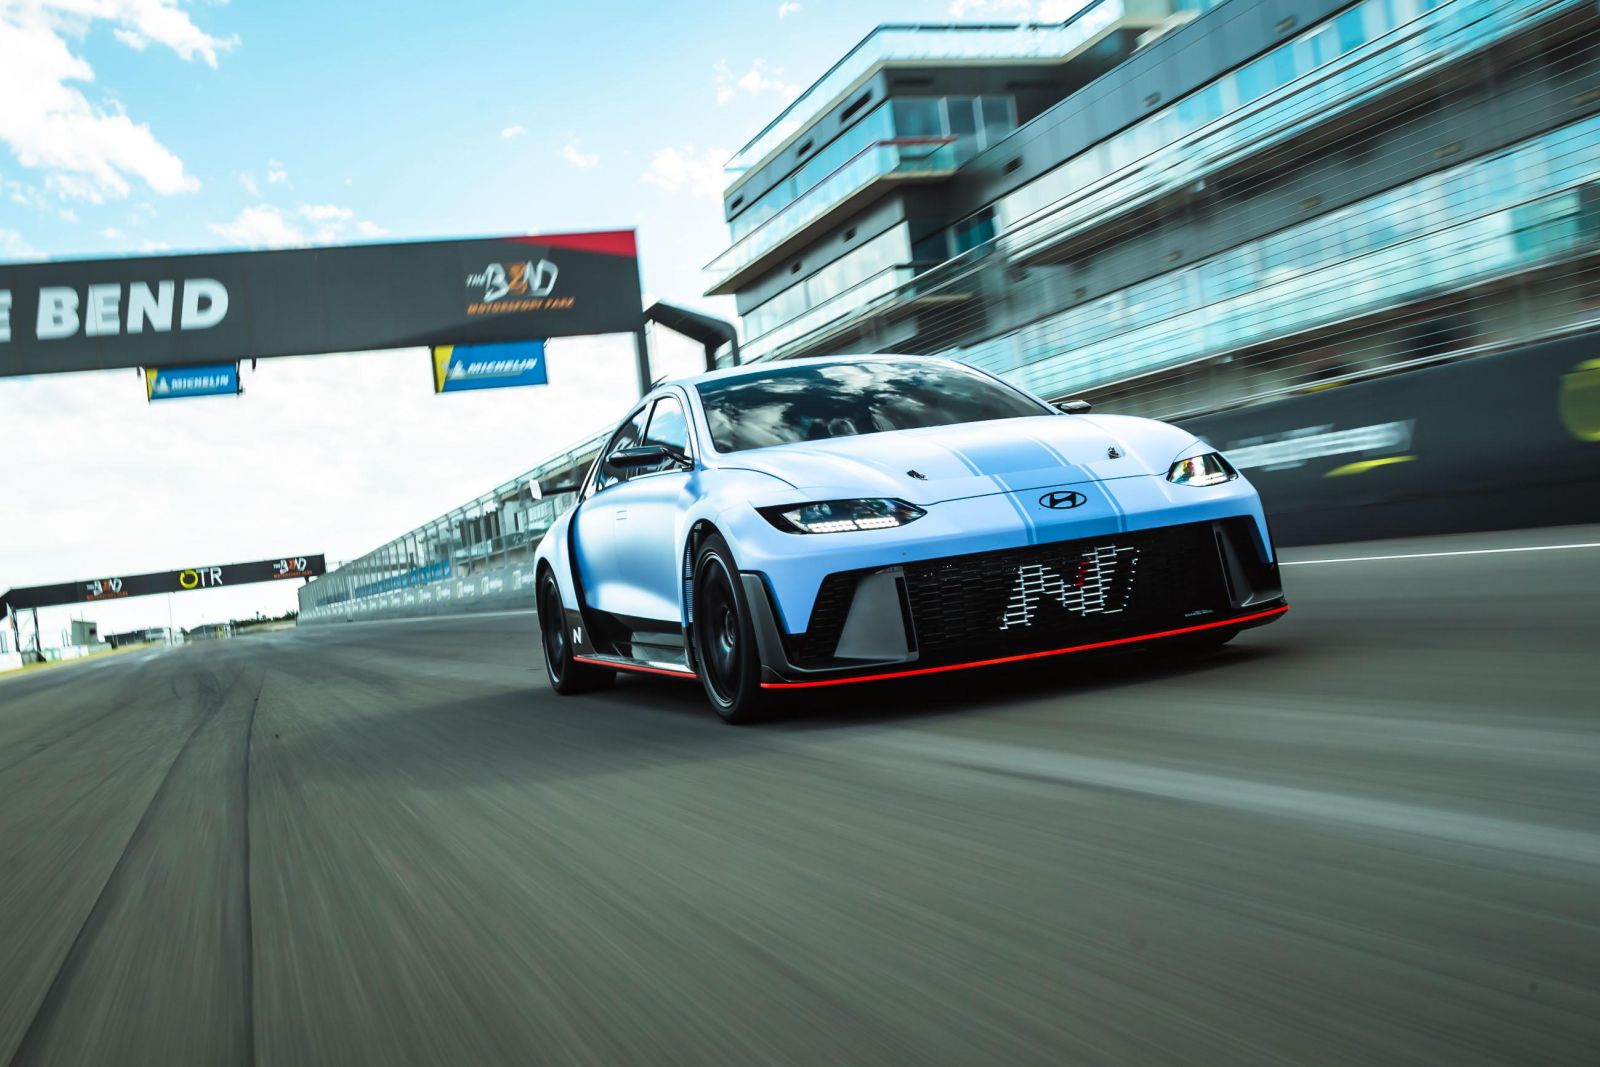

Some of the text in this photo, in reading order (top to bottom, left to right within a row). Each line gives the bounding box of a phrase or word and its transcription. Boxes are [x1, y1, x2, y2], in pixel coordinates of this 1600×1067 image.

[36, 278, 229, 340] BEND
[467, 358, 538, 374] MICHELIN
[171, 375, 229, 390] MICHELIN
[180, 567, 223, 589] OTR
[572, 626, 582, 645] N
